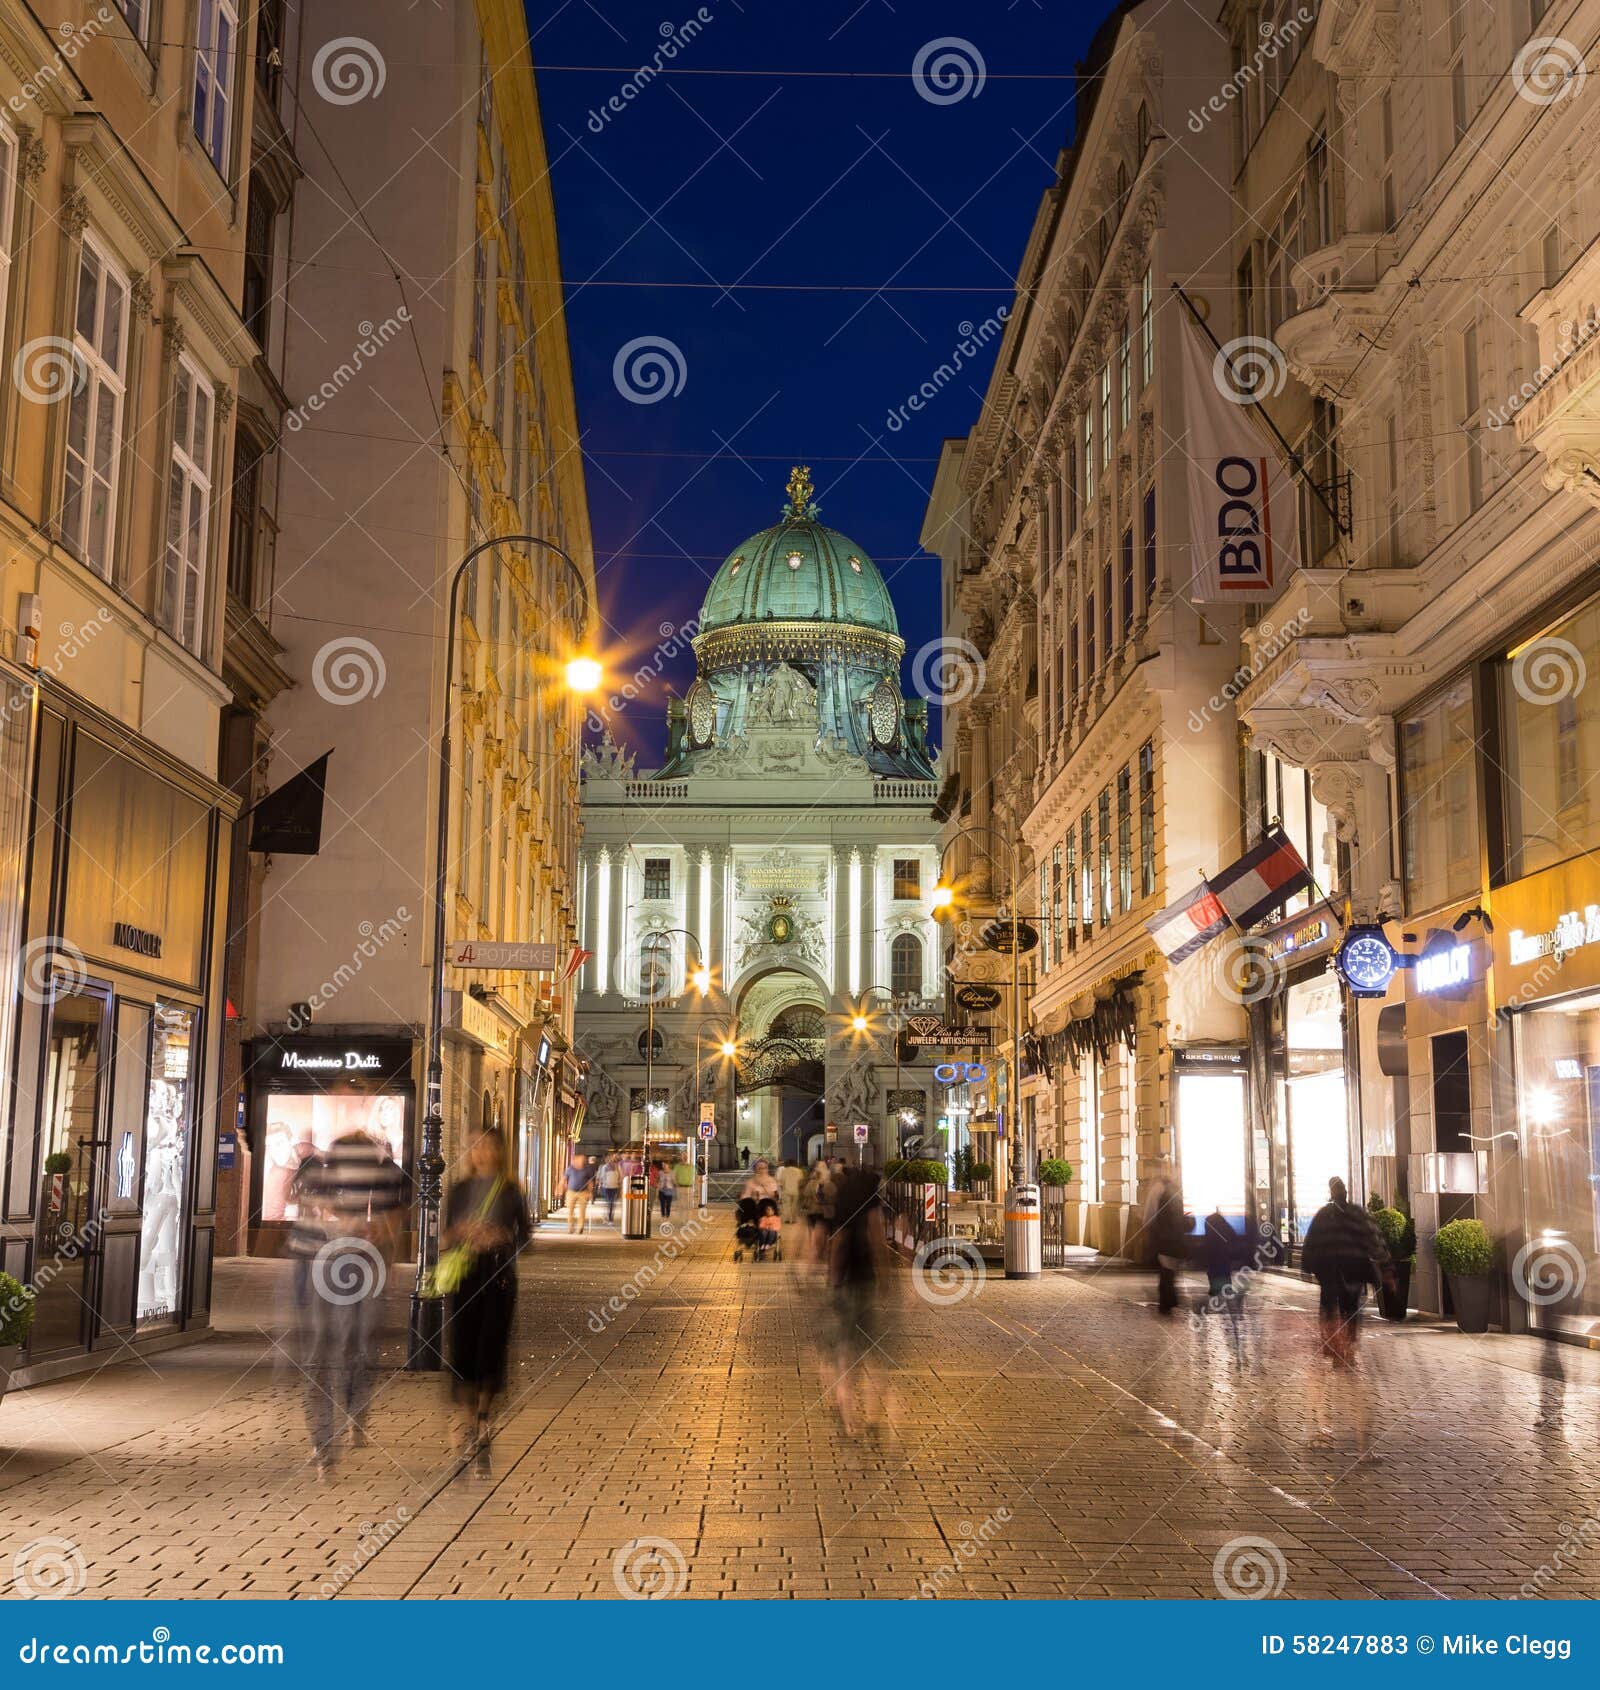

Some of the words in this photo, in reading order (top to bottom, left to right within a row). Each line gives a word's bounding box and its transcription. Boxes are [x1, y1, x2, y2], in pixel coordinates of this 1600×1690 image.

[1215, 456, 1261, 575] BDO
[458, 944, 552, 964] APOTHEKE
[282, 1052, 343, 1069] Massimo
[345, 1052, 382, 1069] Dutti
